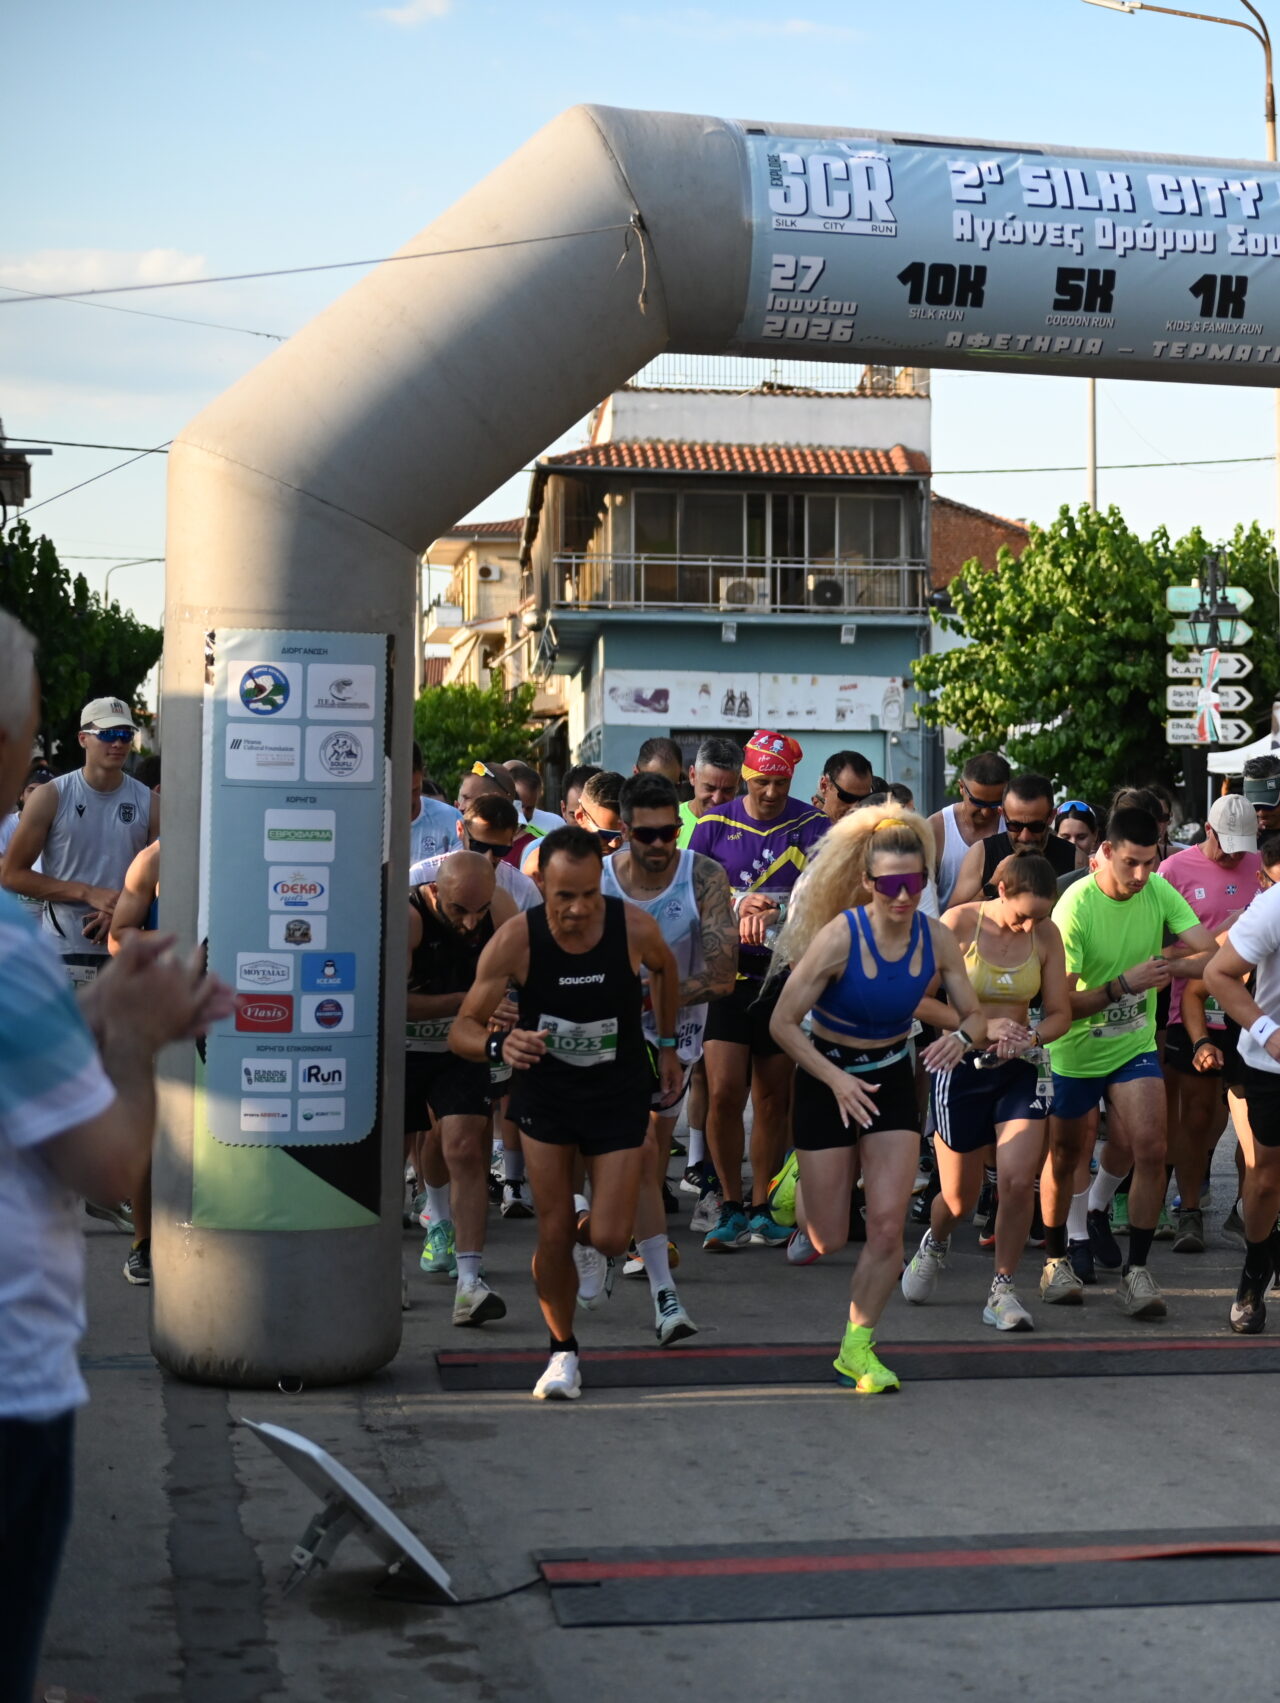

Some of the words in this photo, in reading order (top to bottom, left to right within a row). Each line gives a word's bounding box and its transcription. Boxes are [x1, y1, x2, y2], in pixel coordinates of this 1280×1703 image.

[1018, 164, 1137, 214] SILK
[1146, 174, 1264, 219] CITY
[775, 218, 798, 229] SILK
[823, 221, 846, 232] CITY
[871, 224, 894, 235] RUN
[953, 208, 1084, 255] Αγώνες
[770, 253, 826, 294] 27
[897, 261, 988, 308] 10K
[1052, 266, 1117, 314] 5K
[1189, 273, 1250, 320] 1K
[909, 307, 938, 320] SILK
[939, 309, 965, 322] RUN
[1045, 314, 1091, 327] COCOON
[1093, 316, 1115, 329] RUN
[761, 316, 855, 343] 2026
[1166, 320, 1192, 332] KIDS
[1202, 322, 1238, 334] FAMILY
[1239, 323, 1263, 335] RUN
[281, 883, 317, 894] DEKA
[559, 973, 605, 985] saucony
[246, 1007, 283, 1018] Vlasis
[1103, 1004, 1138, 1022] 1036
[551, 1036, 602, 1051] 1023
